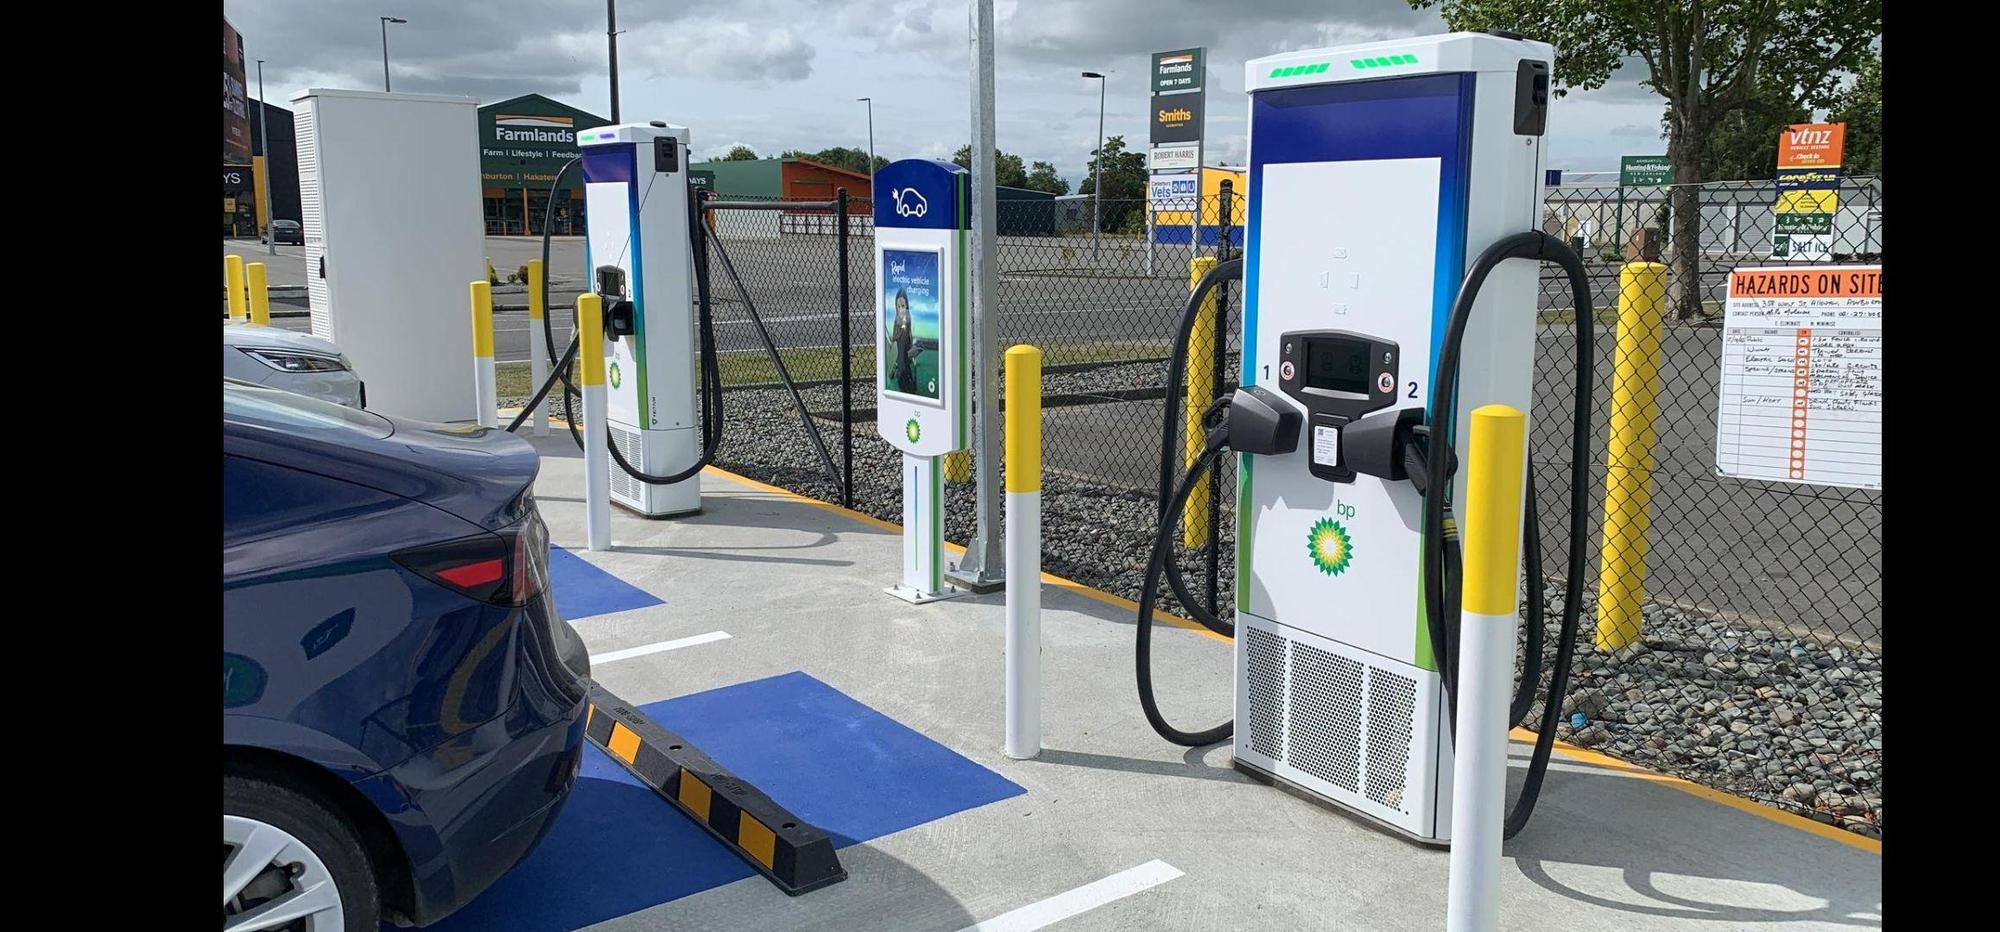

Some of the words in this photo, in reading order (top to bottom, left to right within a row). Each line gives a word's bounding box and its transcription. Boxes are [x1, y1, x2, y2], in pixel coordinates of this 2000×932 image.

[1159, 63, 1192, 75] Farmlands
[1160, 79, 1173, 87] OPEN
[1178, 77, 1191, 85] DAYS
[1158, 108, 1191, 122] Smiths
[496, 127, 574, 143] Farmlands
[1790, 128, 1833, 145] vtnz
[483, 148, 504, 157] Farm
[511, 148, 543, 159] Lifestyle
[1153, 151, 1174, 160] ROBERT
[1174, 150, 1194, 159] HARRIS
[1152, 186, 1171, 198] Vets
[1735, 274, 1811, 295] HAZARDS
[1818, 273, 1841, 294] ON
[1263, 364, 1270, 380] 1
[1407, 381, 1418, 399] 2
[1336, 499, 1356, 520] bp
